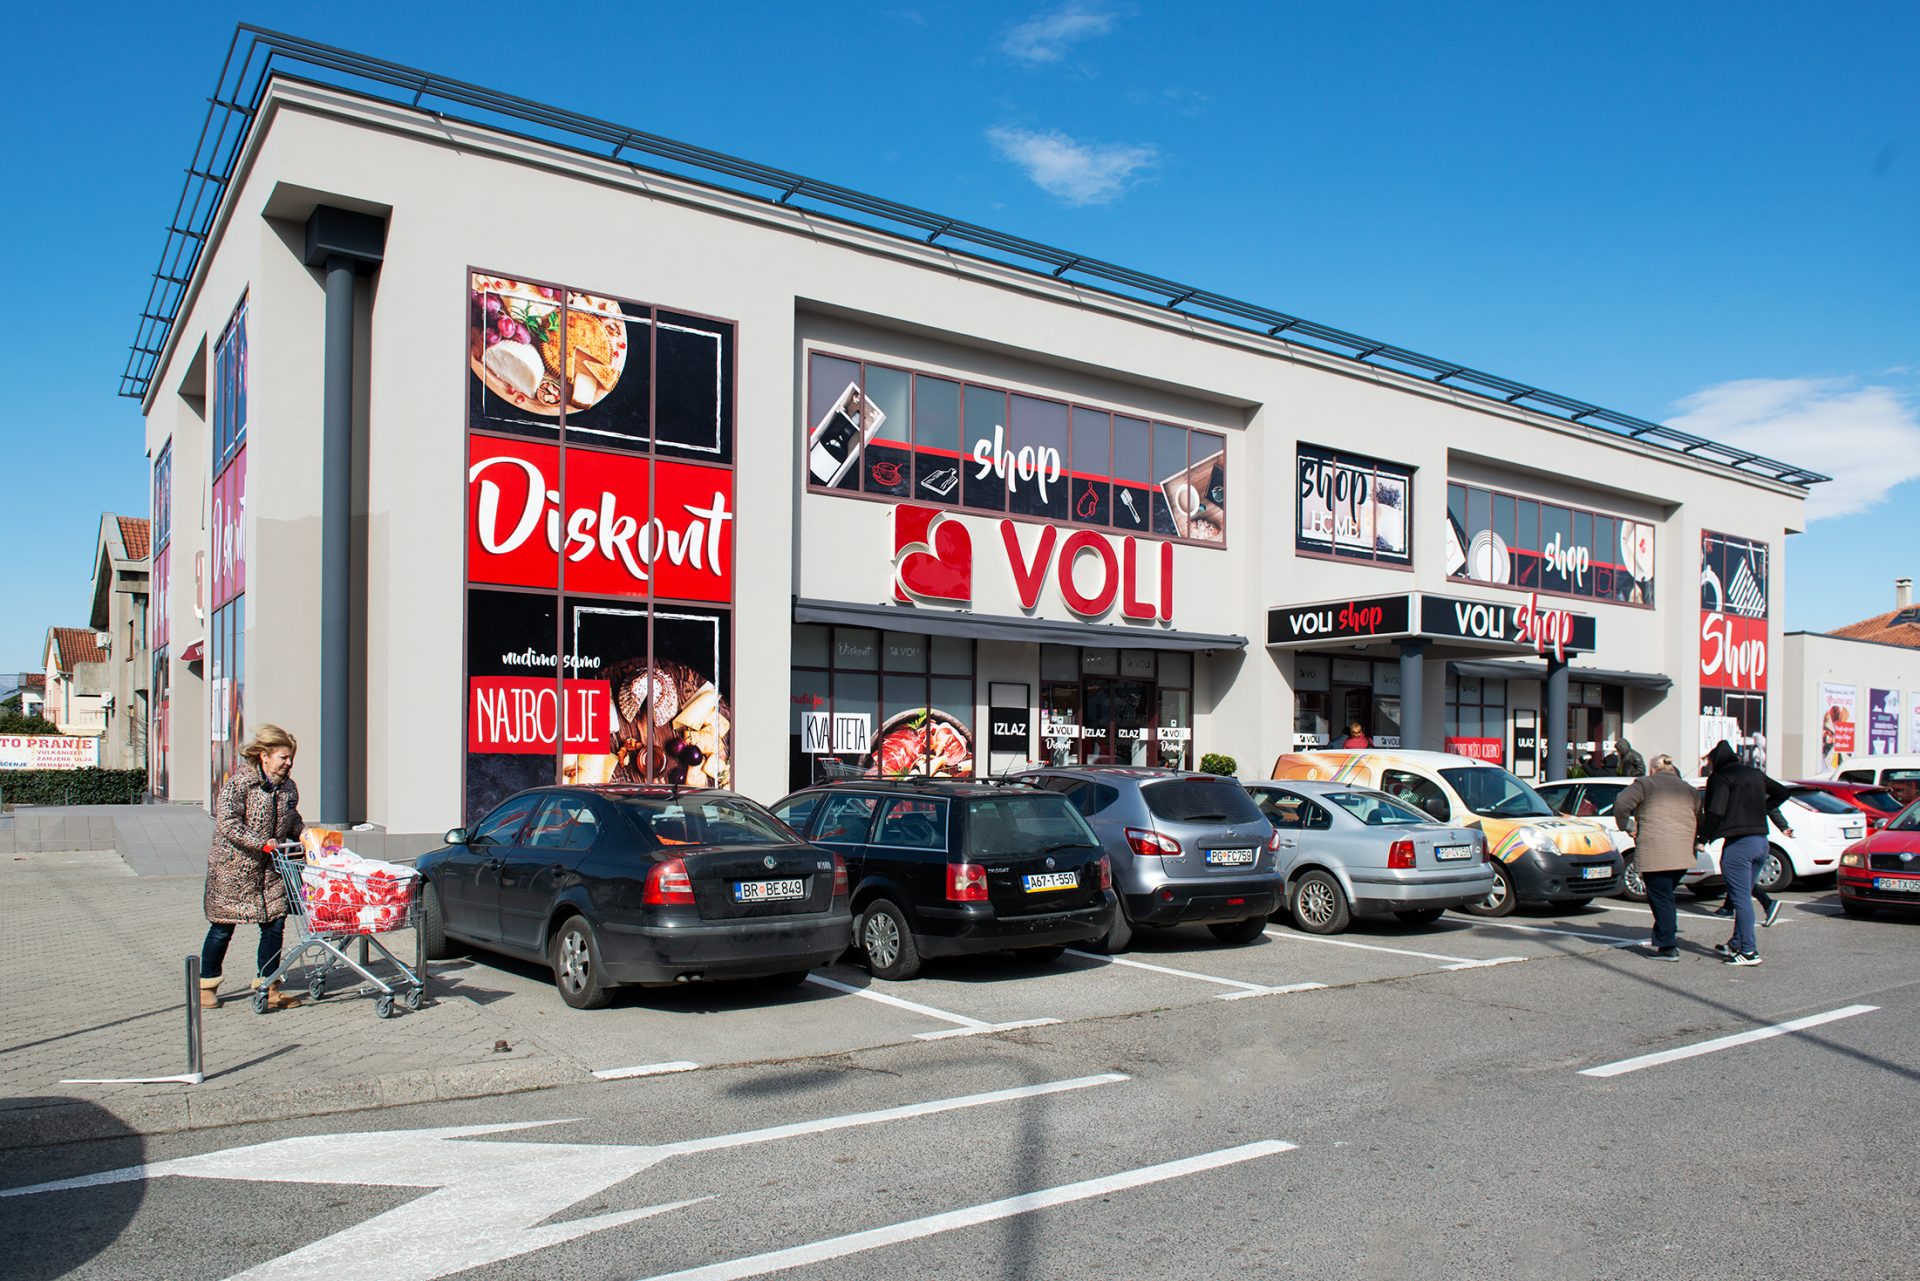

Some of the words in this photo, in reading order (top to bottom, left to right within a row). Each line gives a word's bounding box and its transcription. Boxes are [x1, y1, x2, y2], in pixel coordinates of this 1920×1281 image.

[973, 425, 1060, 504] shop
[1301, 458, 1367, 524] shop
[469, 456, 732, 580] Diskont
[999, 518, 1173, 622] VOLI
[1544, 532, 1589, 588] shop
[1289, 612, 1332, 635] VOLI
[1338, 601, 1383, 635] shop
[1455, 601, 1505, 639] VOLI
[1512, 592, 1574, 663] shop
[502, 647, 557, 669] nudimo
[563, 653, 600, 669] samo
[1701, 612, 1765, 690] Shop
[477, 687, 600, 744] NAJBOLJE
[994, 722, 1026, 736] IZLAZ
[806, 715, 866, 750] KVAITETA
[1056, 726, 1073, 735] VOLI
[1085, 728, 1106, 738] IZLAZ
[1119, 729, 1139, 738] IZLAZ
[1518, 738, 1534, 748] ULAZ
[1212, 851, 1223, 861] PG
[1228, 851, 1251, 861] FC759
[743, 884, 758, 897] BR
[1030, 873, 1074, 888] A67-T-559
[1880, 880, 1891, 888] PG
